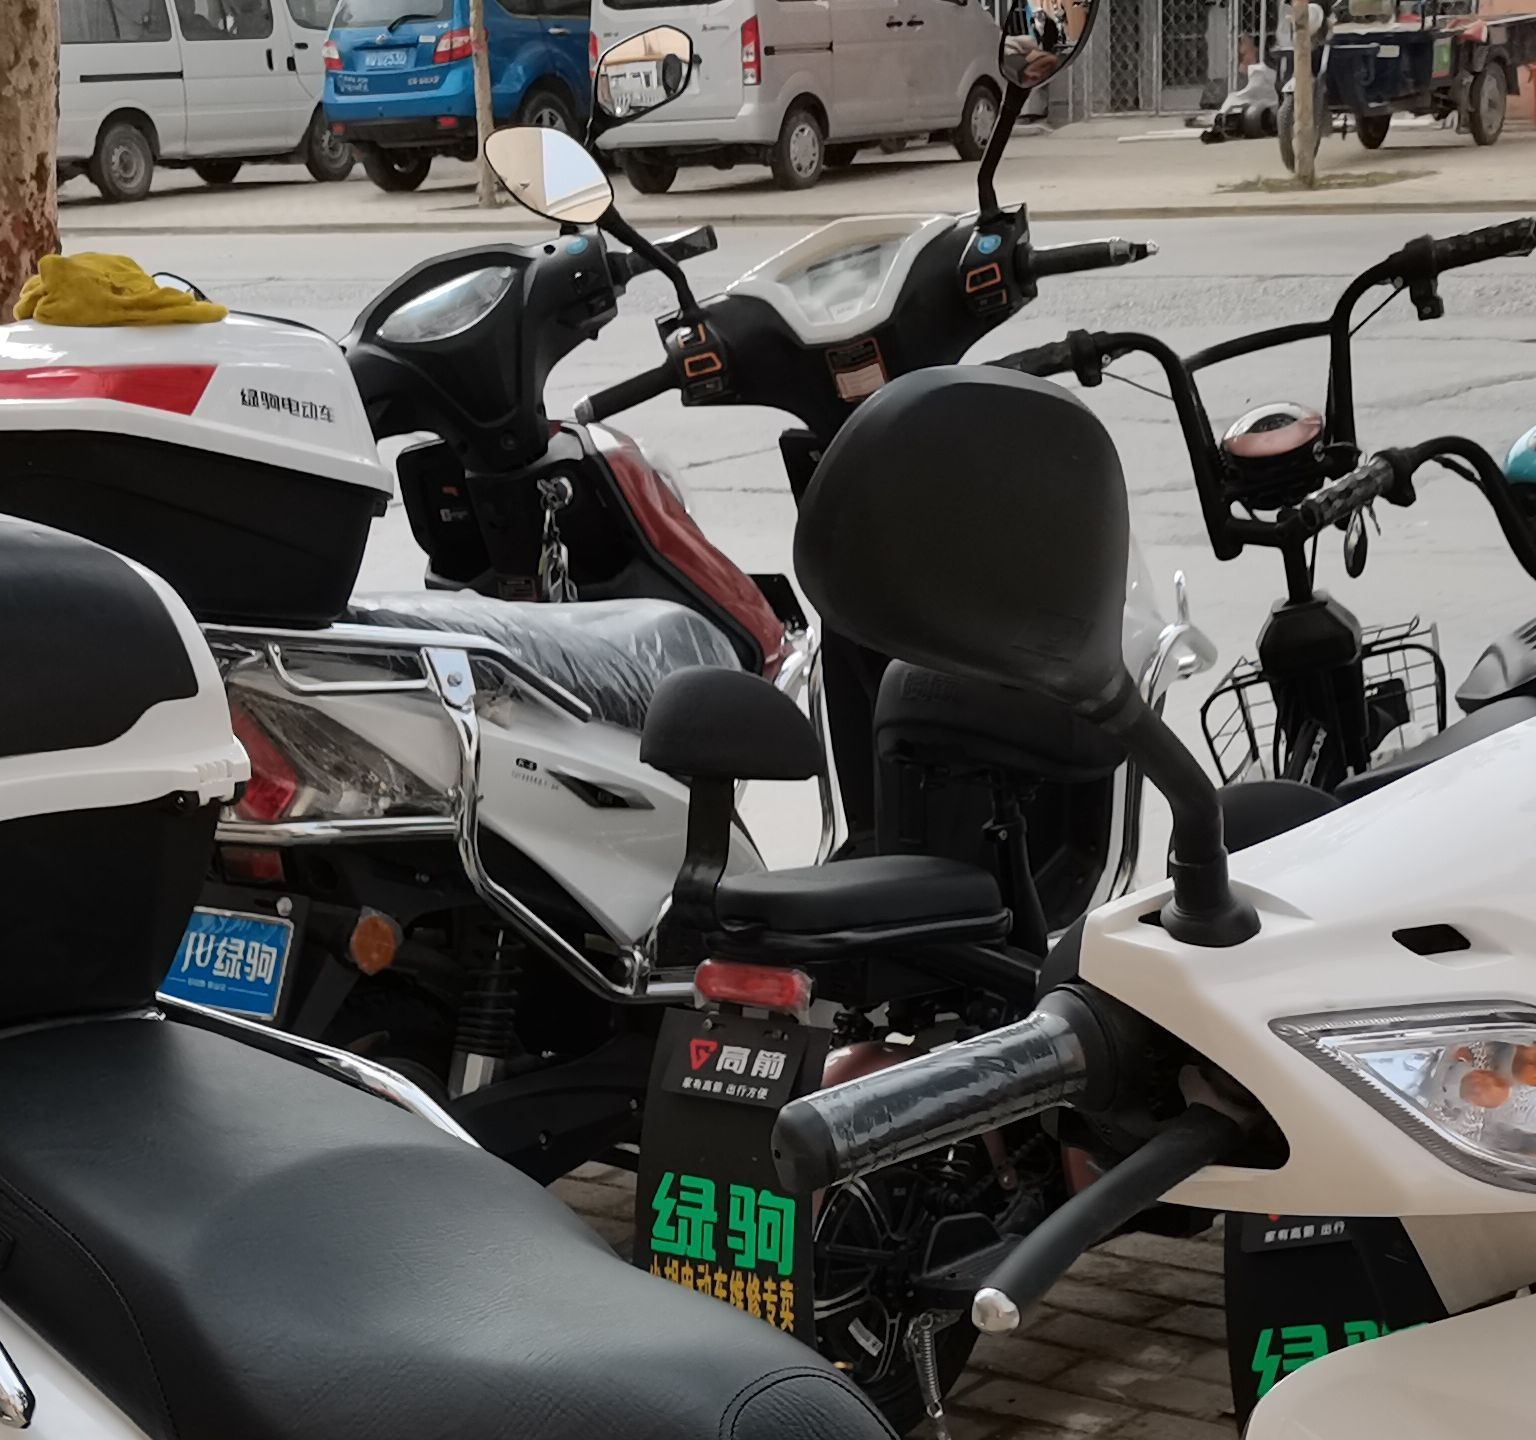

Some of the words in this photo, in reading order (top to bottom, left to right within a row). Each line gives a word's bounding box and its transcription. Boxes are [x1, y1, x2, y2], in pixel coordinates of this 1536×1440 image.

[241, 388, 333, 422] 绿驹电动车
[650, 1171, 796, 1276] 绿驹
